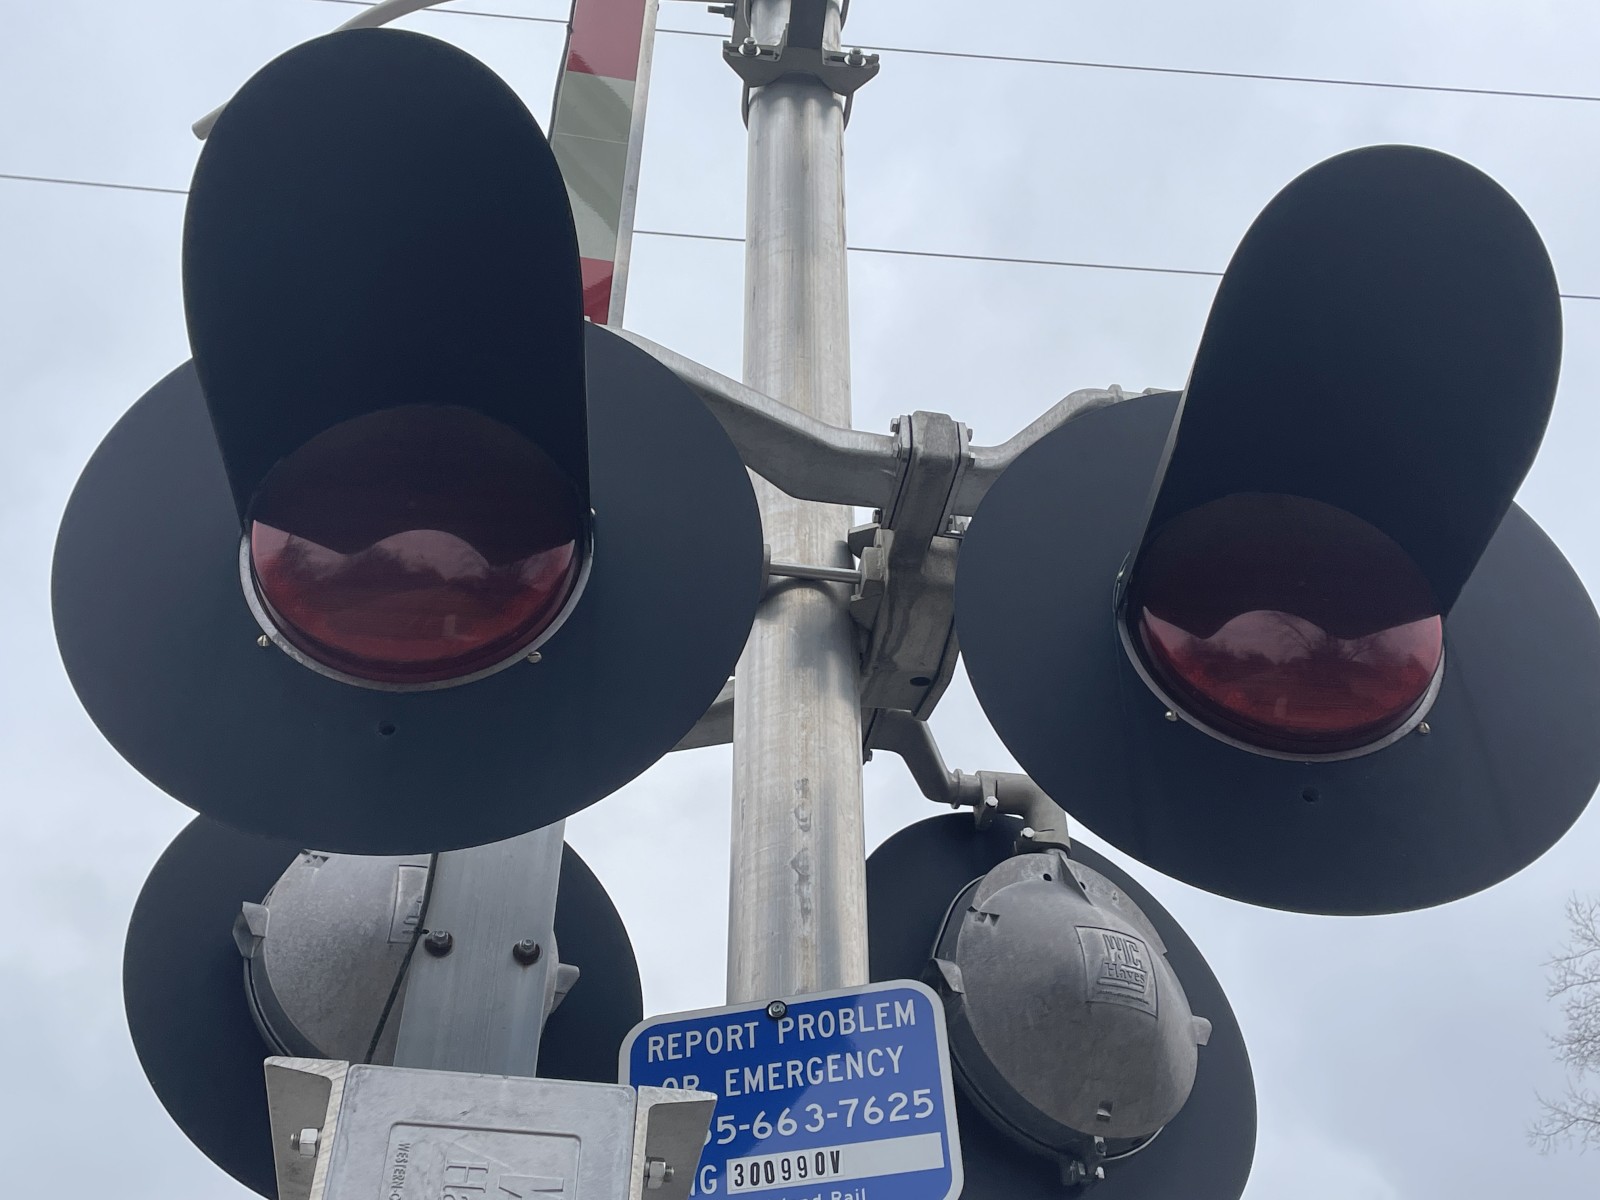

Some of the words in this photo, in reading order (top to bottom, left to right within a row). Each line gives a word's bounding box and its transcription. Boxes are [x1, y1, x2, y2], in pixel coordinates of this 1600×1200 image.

[647, 1021, 760, 1063] REPORT
[777, 999, 916, 1044] PROBLEM
[725, 1045, 904, 1097] EMERGENCY
[704, 1088, 935, 1146] 5-663-7625
[734, 1150, 841, 1187] 300990V
